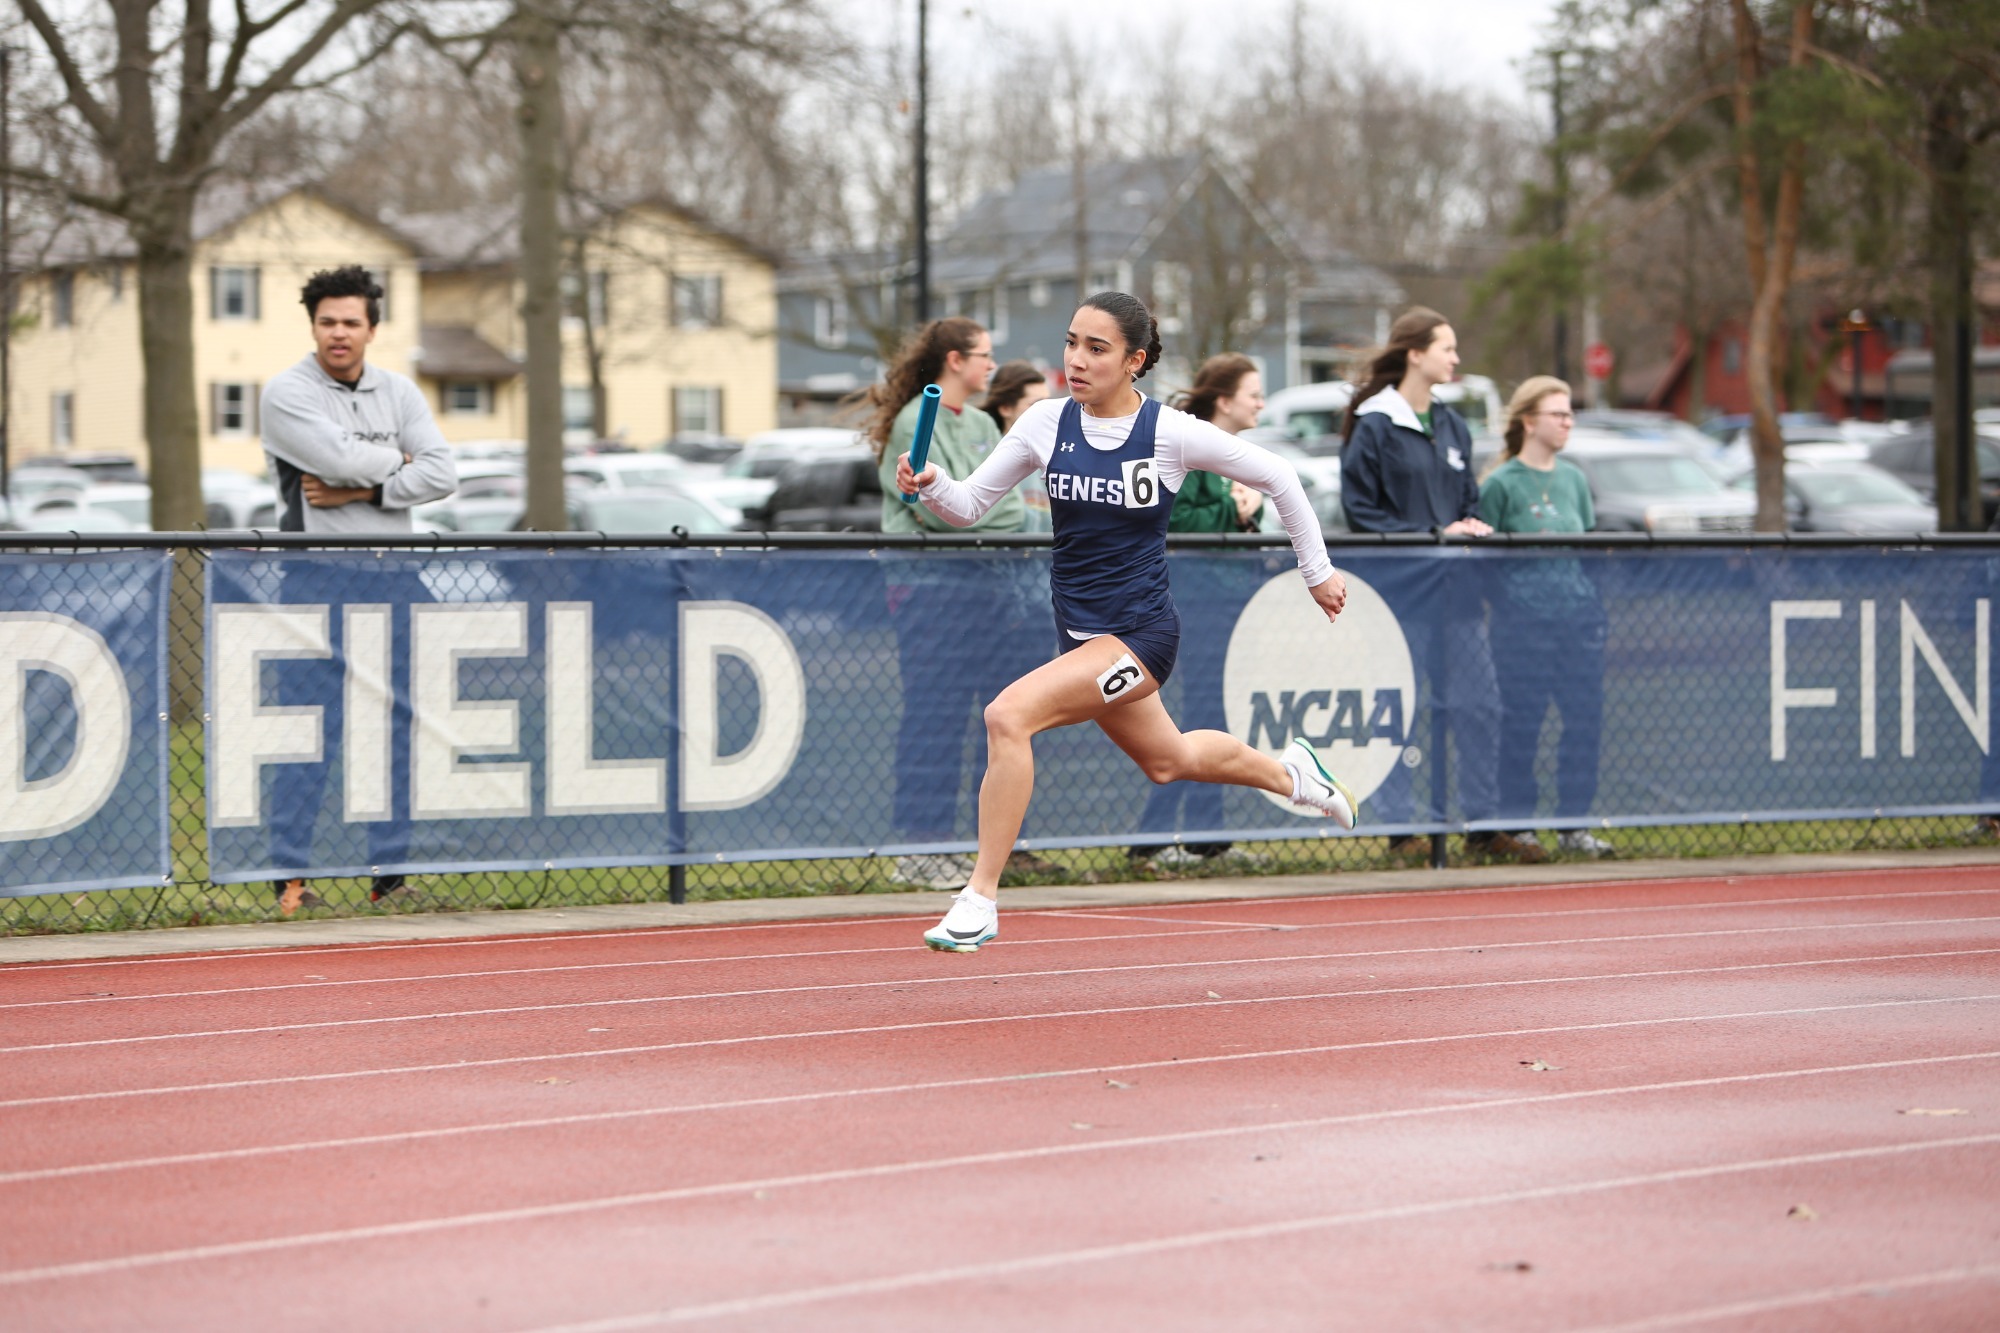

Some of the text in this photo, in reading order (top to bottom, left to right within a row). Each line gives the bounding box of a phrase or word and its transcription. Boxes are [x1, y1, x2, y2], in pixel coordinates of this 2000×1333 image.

[1132, 462, 1153, 505] 6
[1103, 666, 1139, 695] 6
[1770, 598, 1990, 762] FIN
[211, 601, 806, 827] FIELD
[1248, 688, 1406, 750] NCAA
